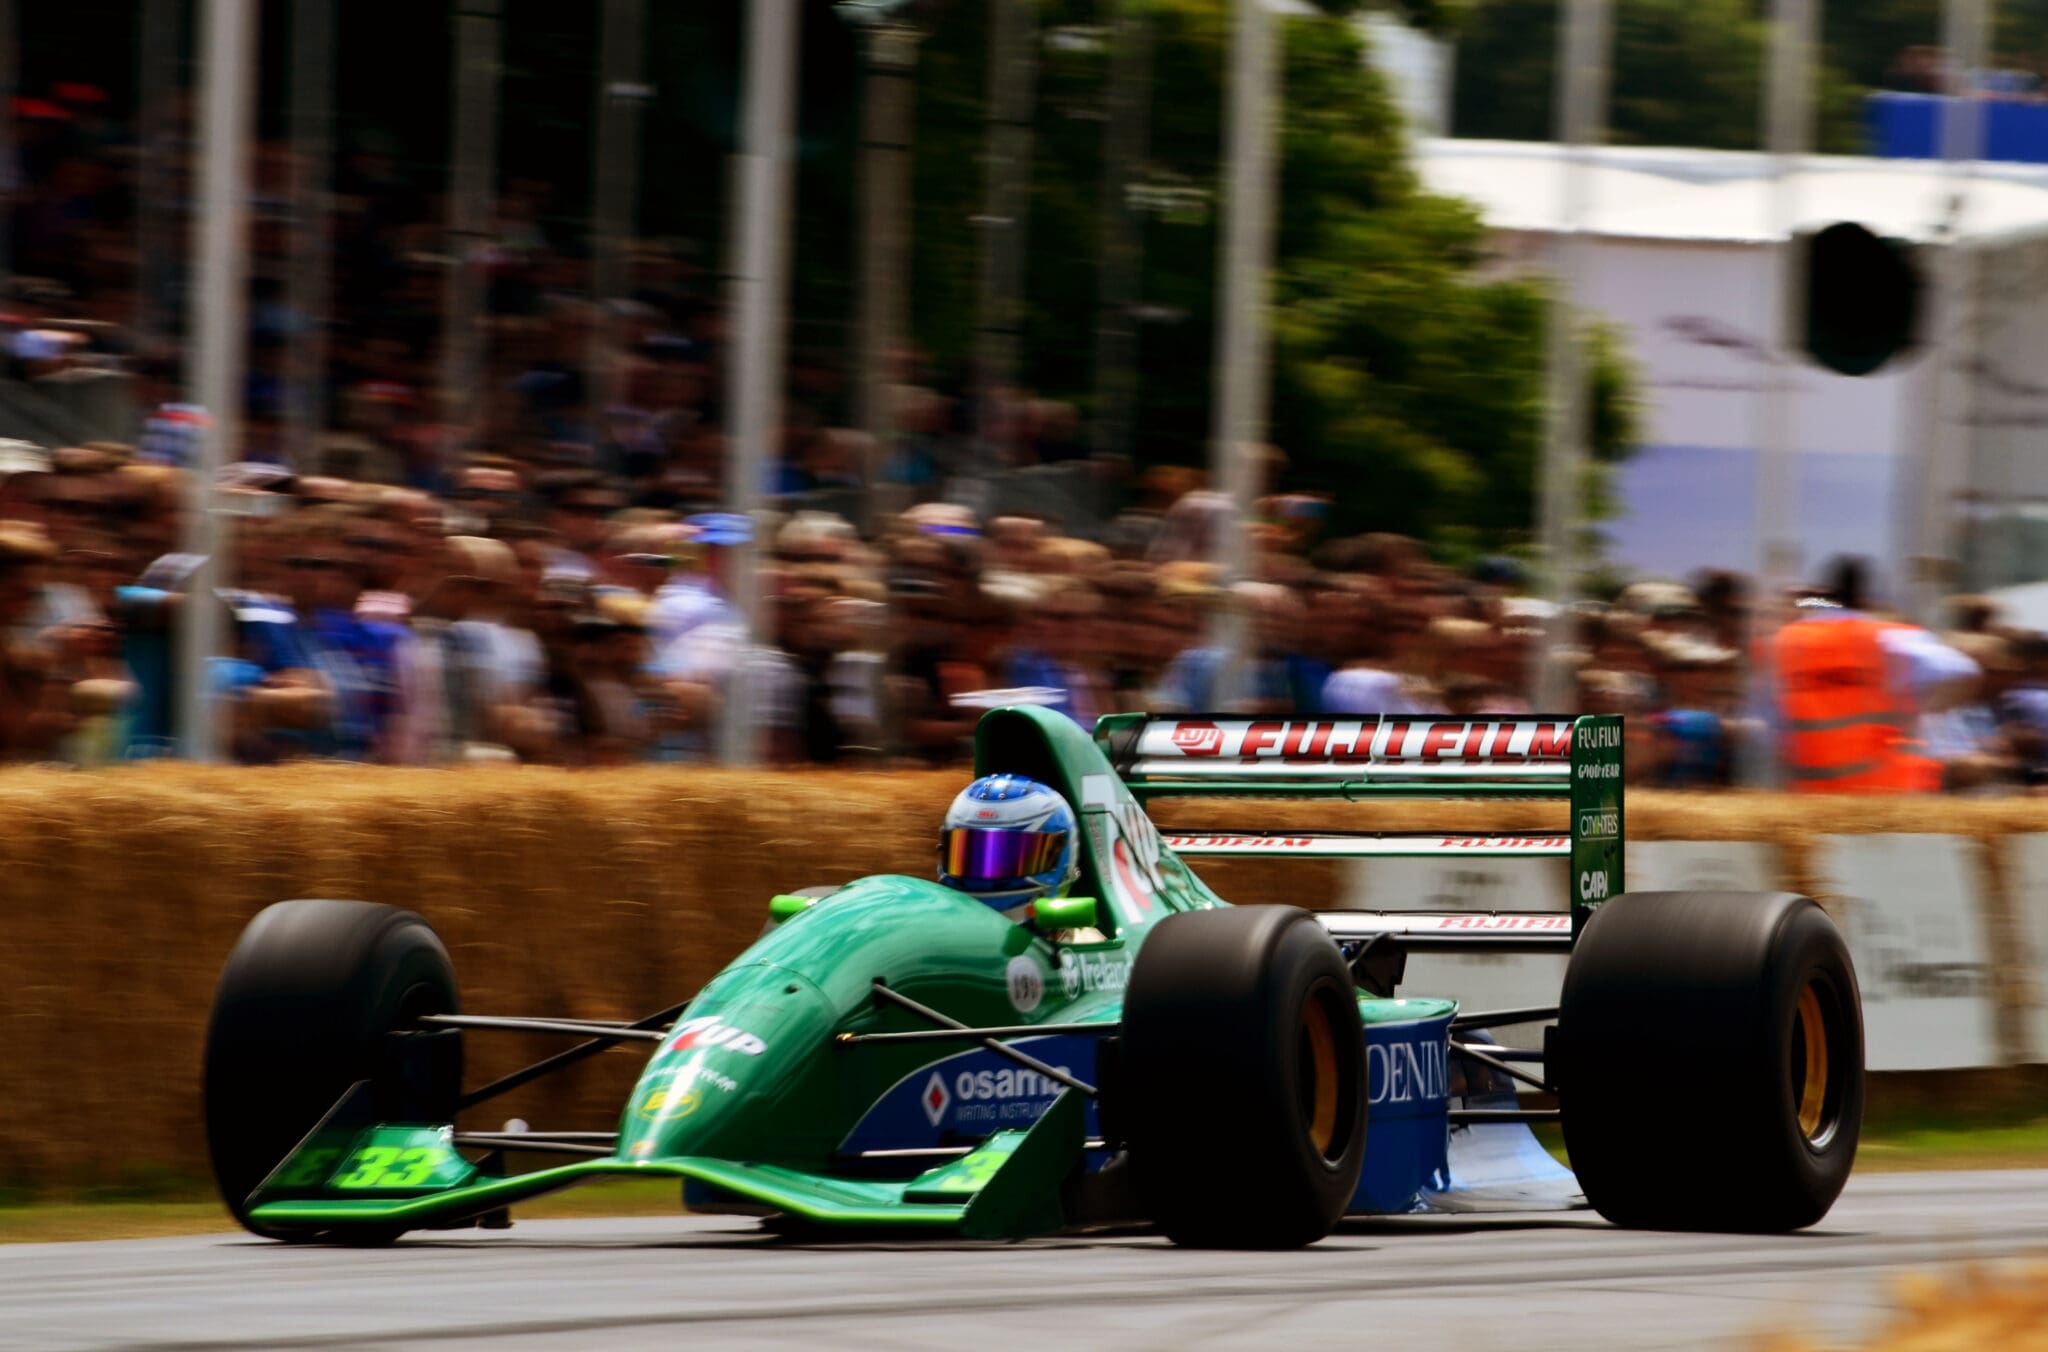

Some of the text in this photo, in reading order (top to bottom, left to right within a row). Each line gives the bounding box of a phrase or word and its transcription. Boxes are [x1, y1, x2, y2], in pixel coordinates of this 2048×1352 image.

[1239, 721, 1571, 757] FUJIFILM
[1169, 836, 1312, 847] UJIFILM
[1440, 837, 1568, 847] FUJIFIL
[1439, 917, 1569, 929] FUJIFIL
[337, 1147, 447, 1187] 33
